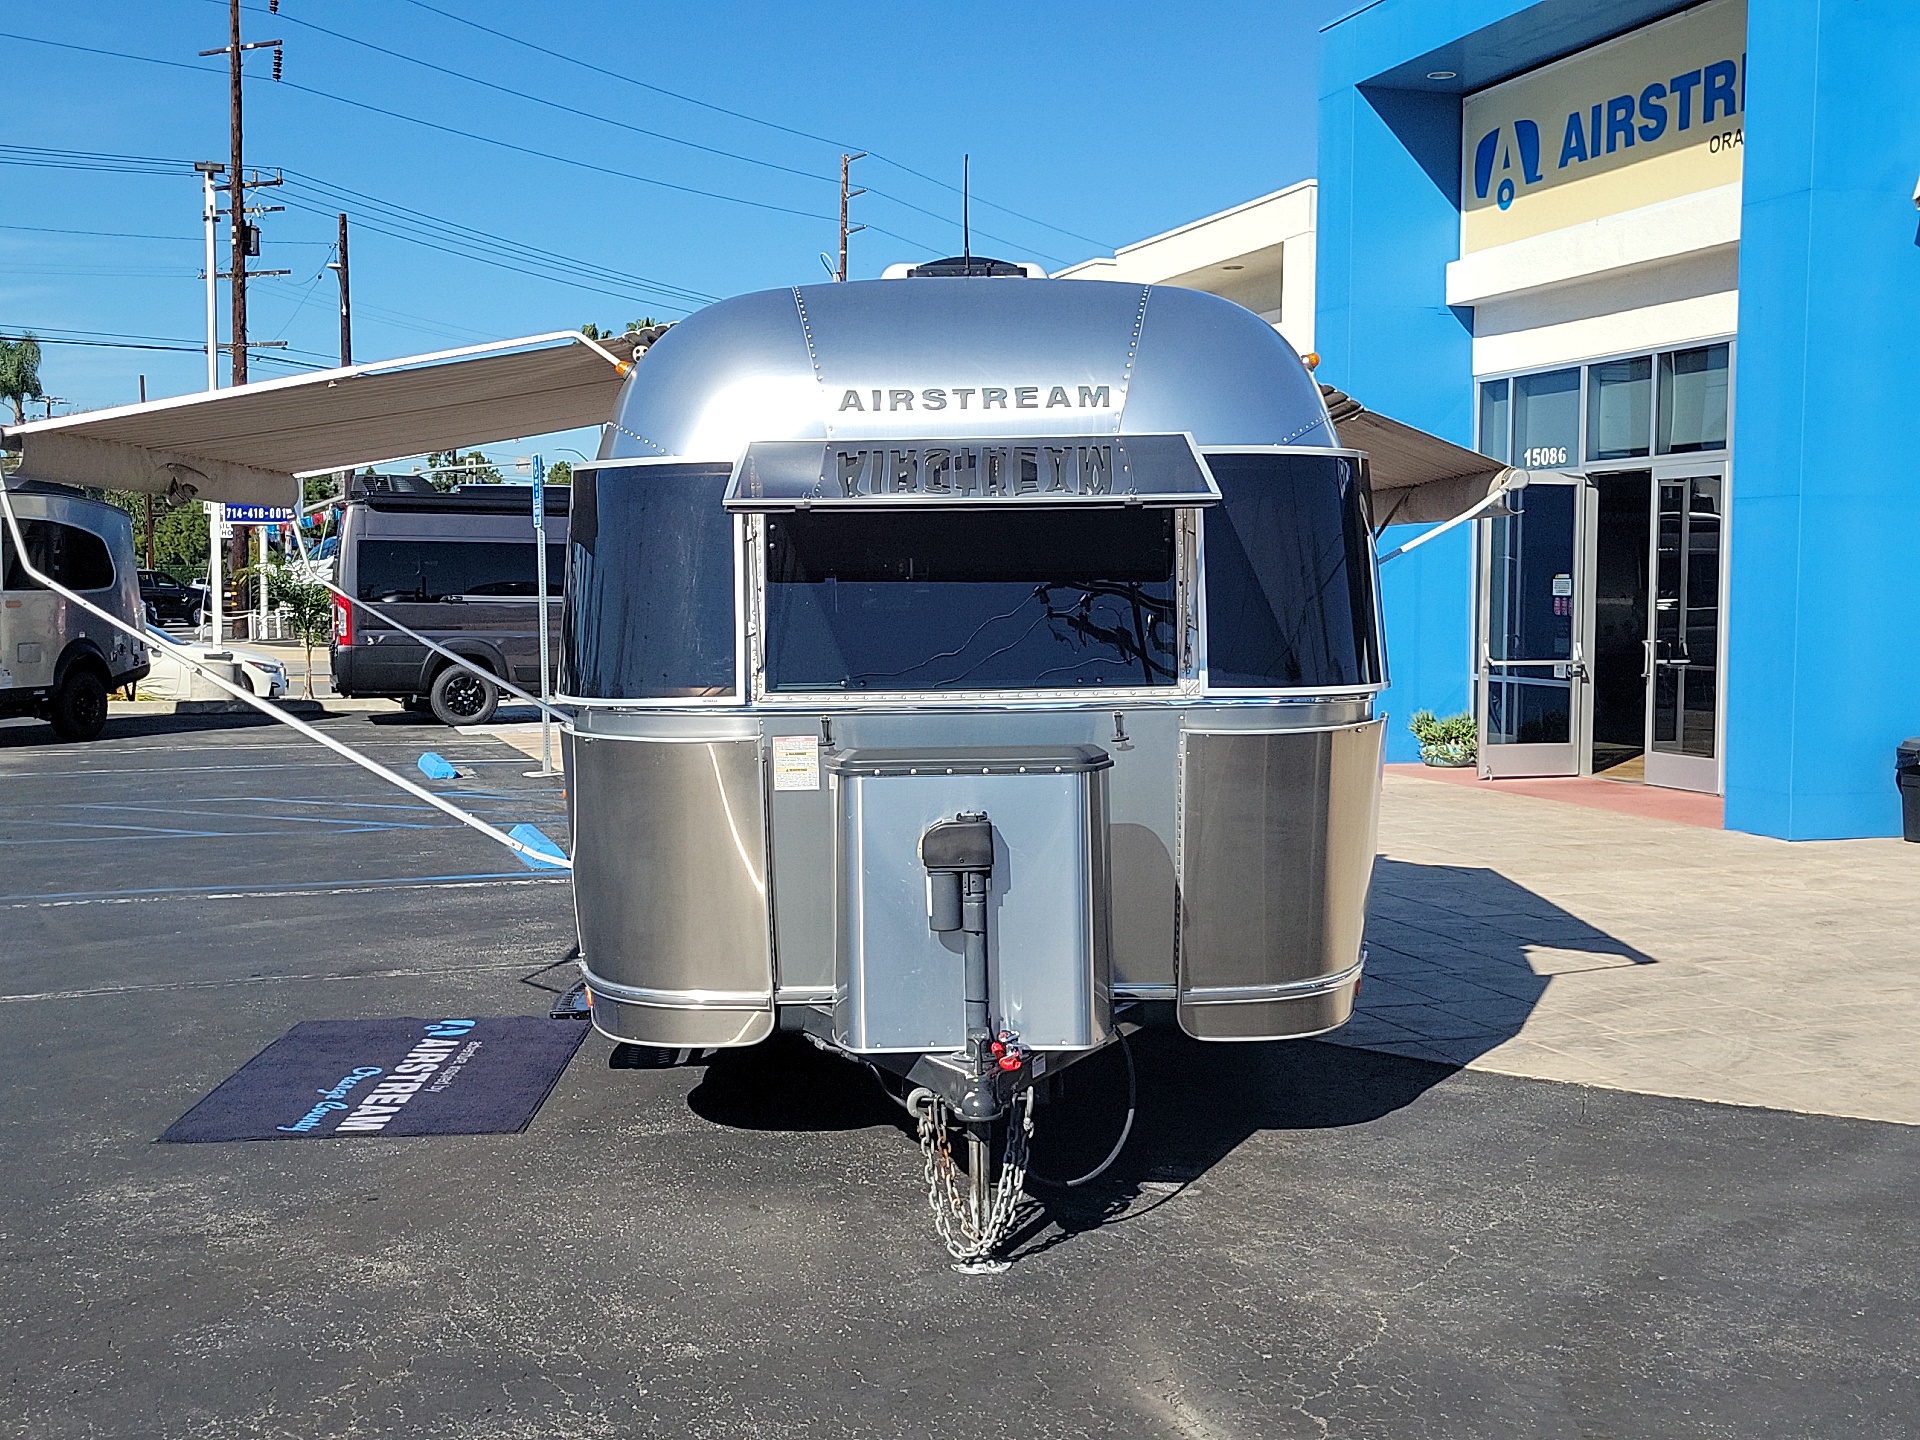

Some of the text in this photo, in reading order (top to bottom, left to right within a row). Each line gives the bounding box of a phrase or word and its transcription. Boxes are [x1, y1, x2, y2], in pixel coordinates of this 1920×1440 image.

[1558, 52, 1747, 169] AIRSTR
[838, 386, 1111, 411] AIRSTREAM
[1524, 446, 1567, 467] 15086
[226, 507, 291, 519] 714-418-001
[276, 1066, 383, 1132] Orange County
[335, 1038, 461, 1132] AIRSTREAM
